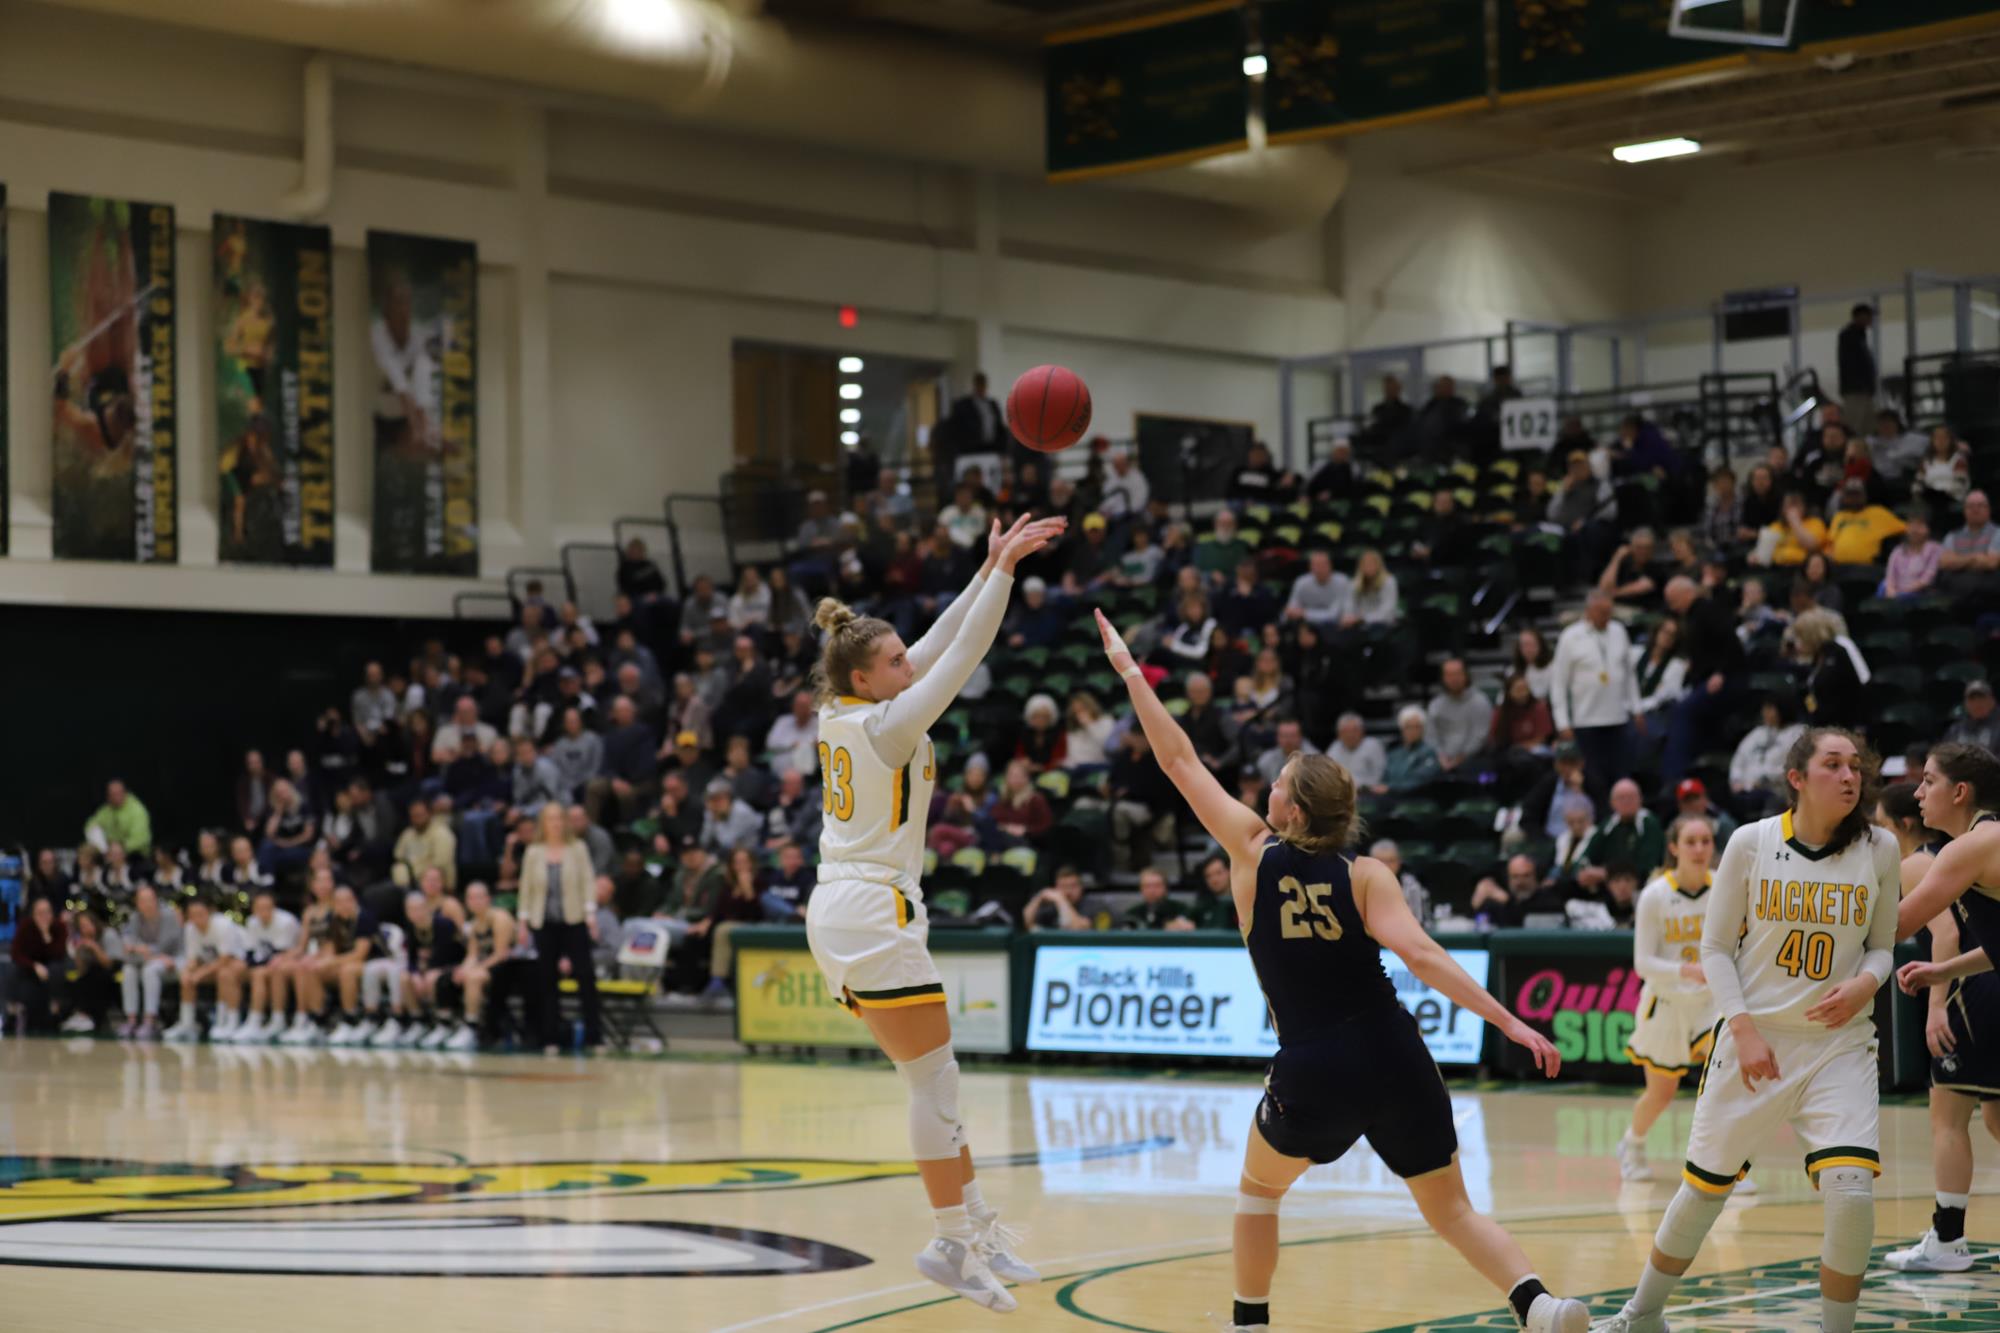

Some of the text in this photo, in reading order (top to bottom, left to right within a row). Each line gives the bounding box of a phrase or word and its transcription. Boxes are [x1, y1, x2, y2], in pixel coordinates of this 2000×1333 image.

[297, 250, 331, 549] TRIATHLON
[1507, 411, 1550, 438] 102
[818, 741, 854, 821] 33
[1279, 875, 1343, 941] 25
[1756, 879, 1868, 927] JACKETS
[1078, 966, 1195, 989] Black Hills
[1776, 929, 1834, 981] 40
[1043, 980, 1231, 1029] Pioneer
